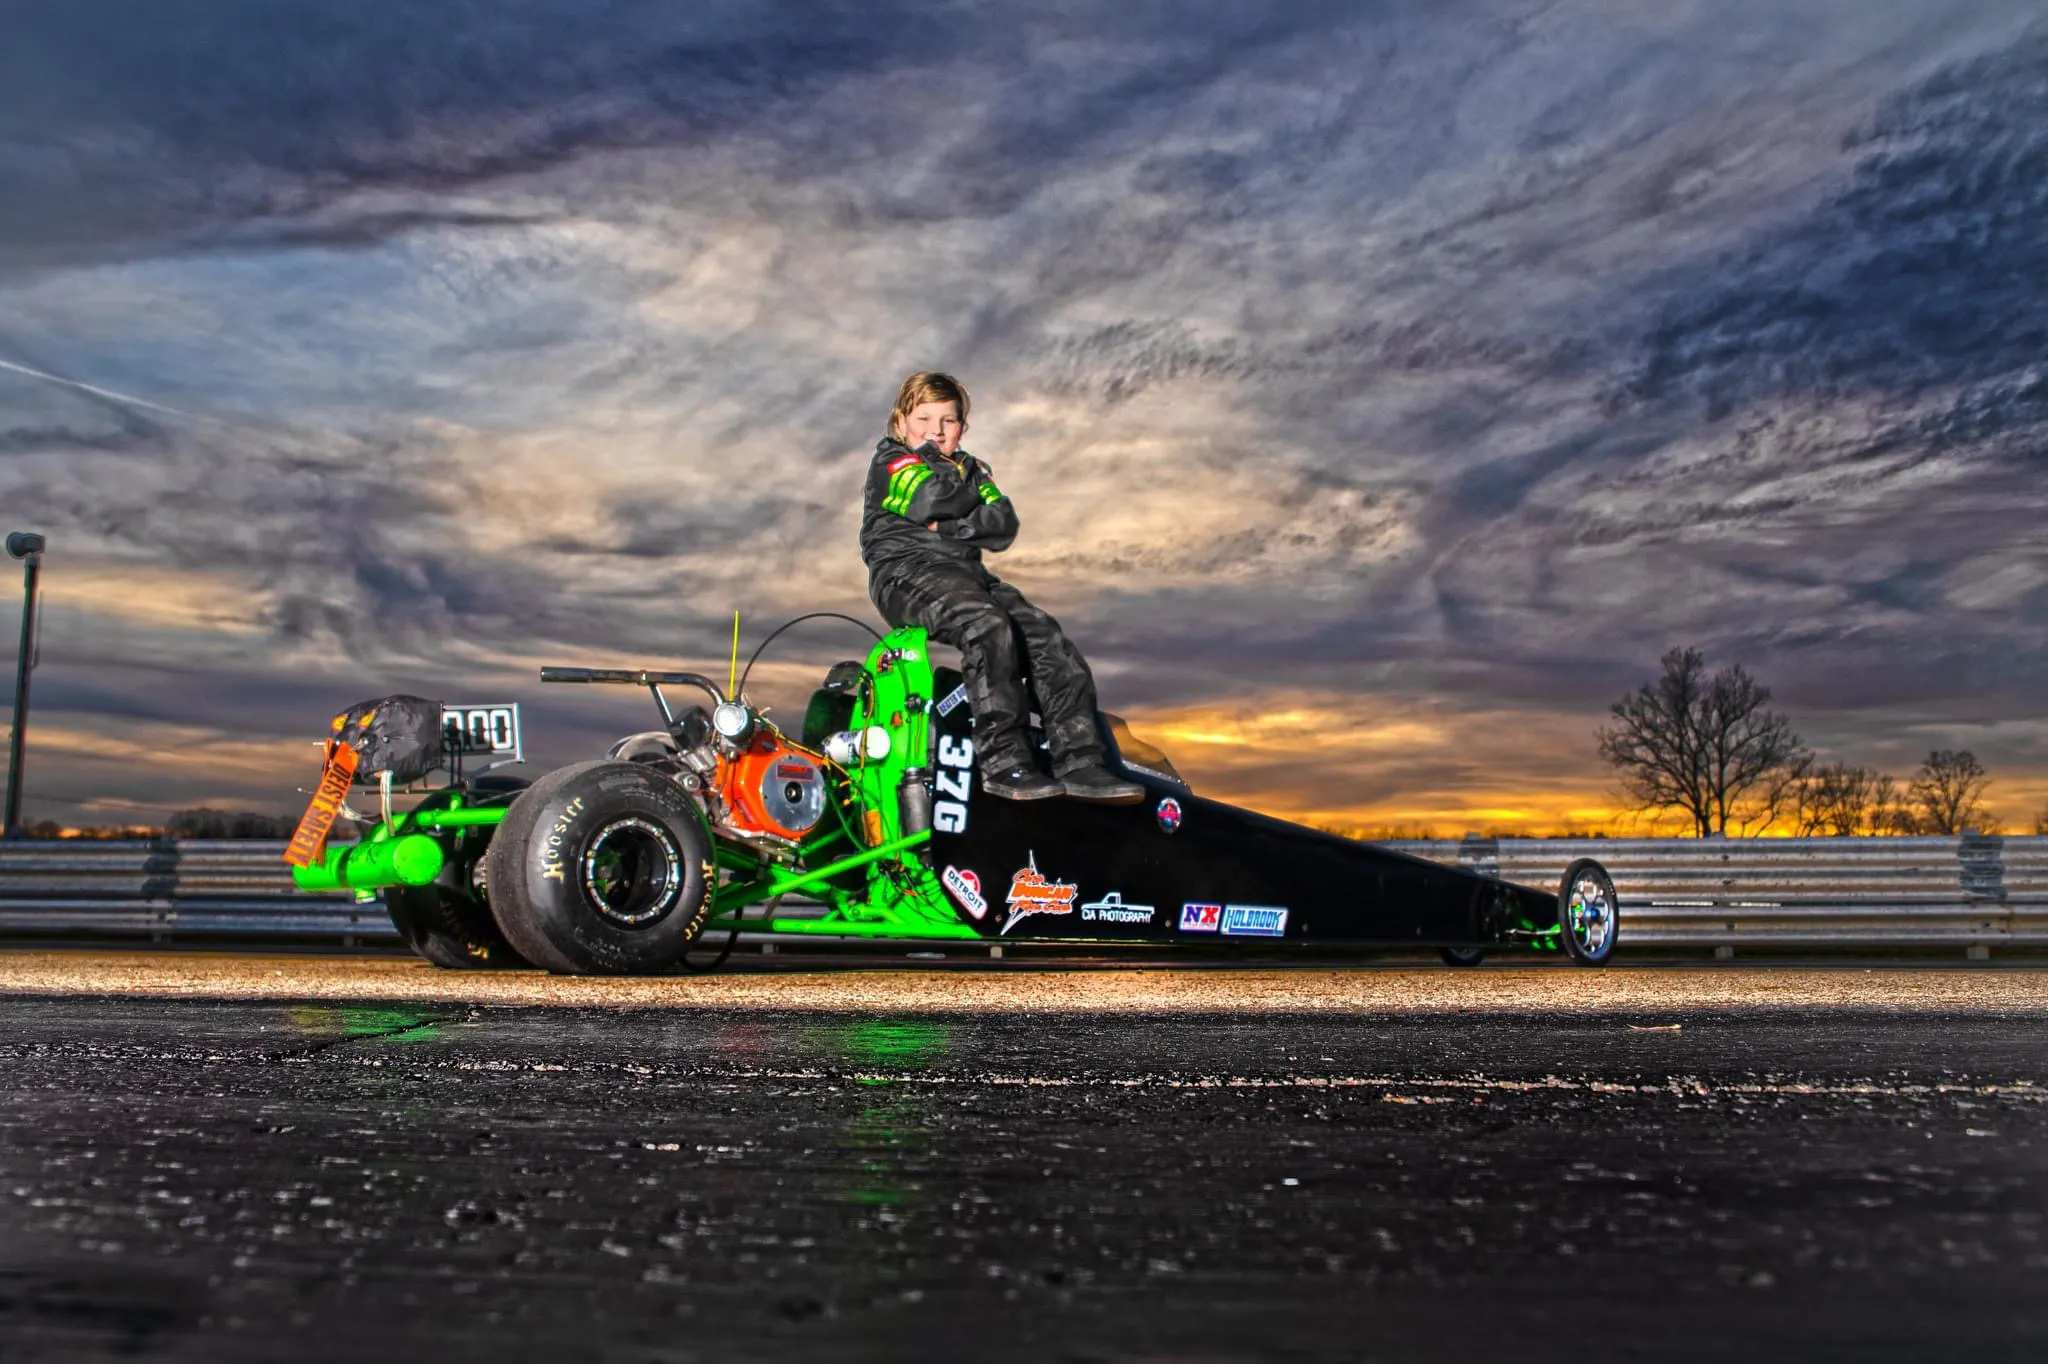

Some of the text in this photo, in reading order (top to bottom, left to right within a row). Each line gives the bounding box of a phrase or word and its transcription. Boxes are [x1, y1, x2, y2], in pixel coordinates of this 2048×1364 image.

[287, 763, 351, 865] DEIST SAFETY
[540, 797, 585, 885] Hoosier
[948, 870, 984, 911] DETROIT
[1098, 909, 1152, 924] PHOTOGRAPHY
[1184, 906, 1219, 924] NX
[1224, 908, 1283, 931] HOLBROOK
